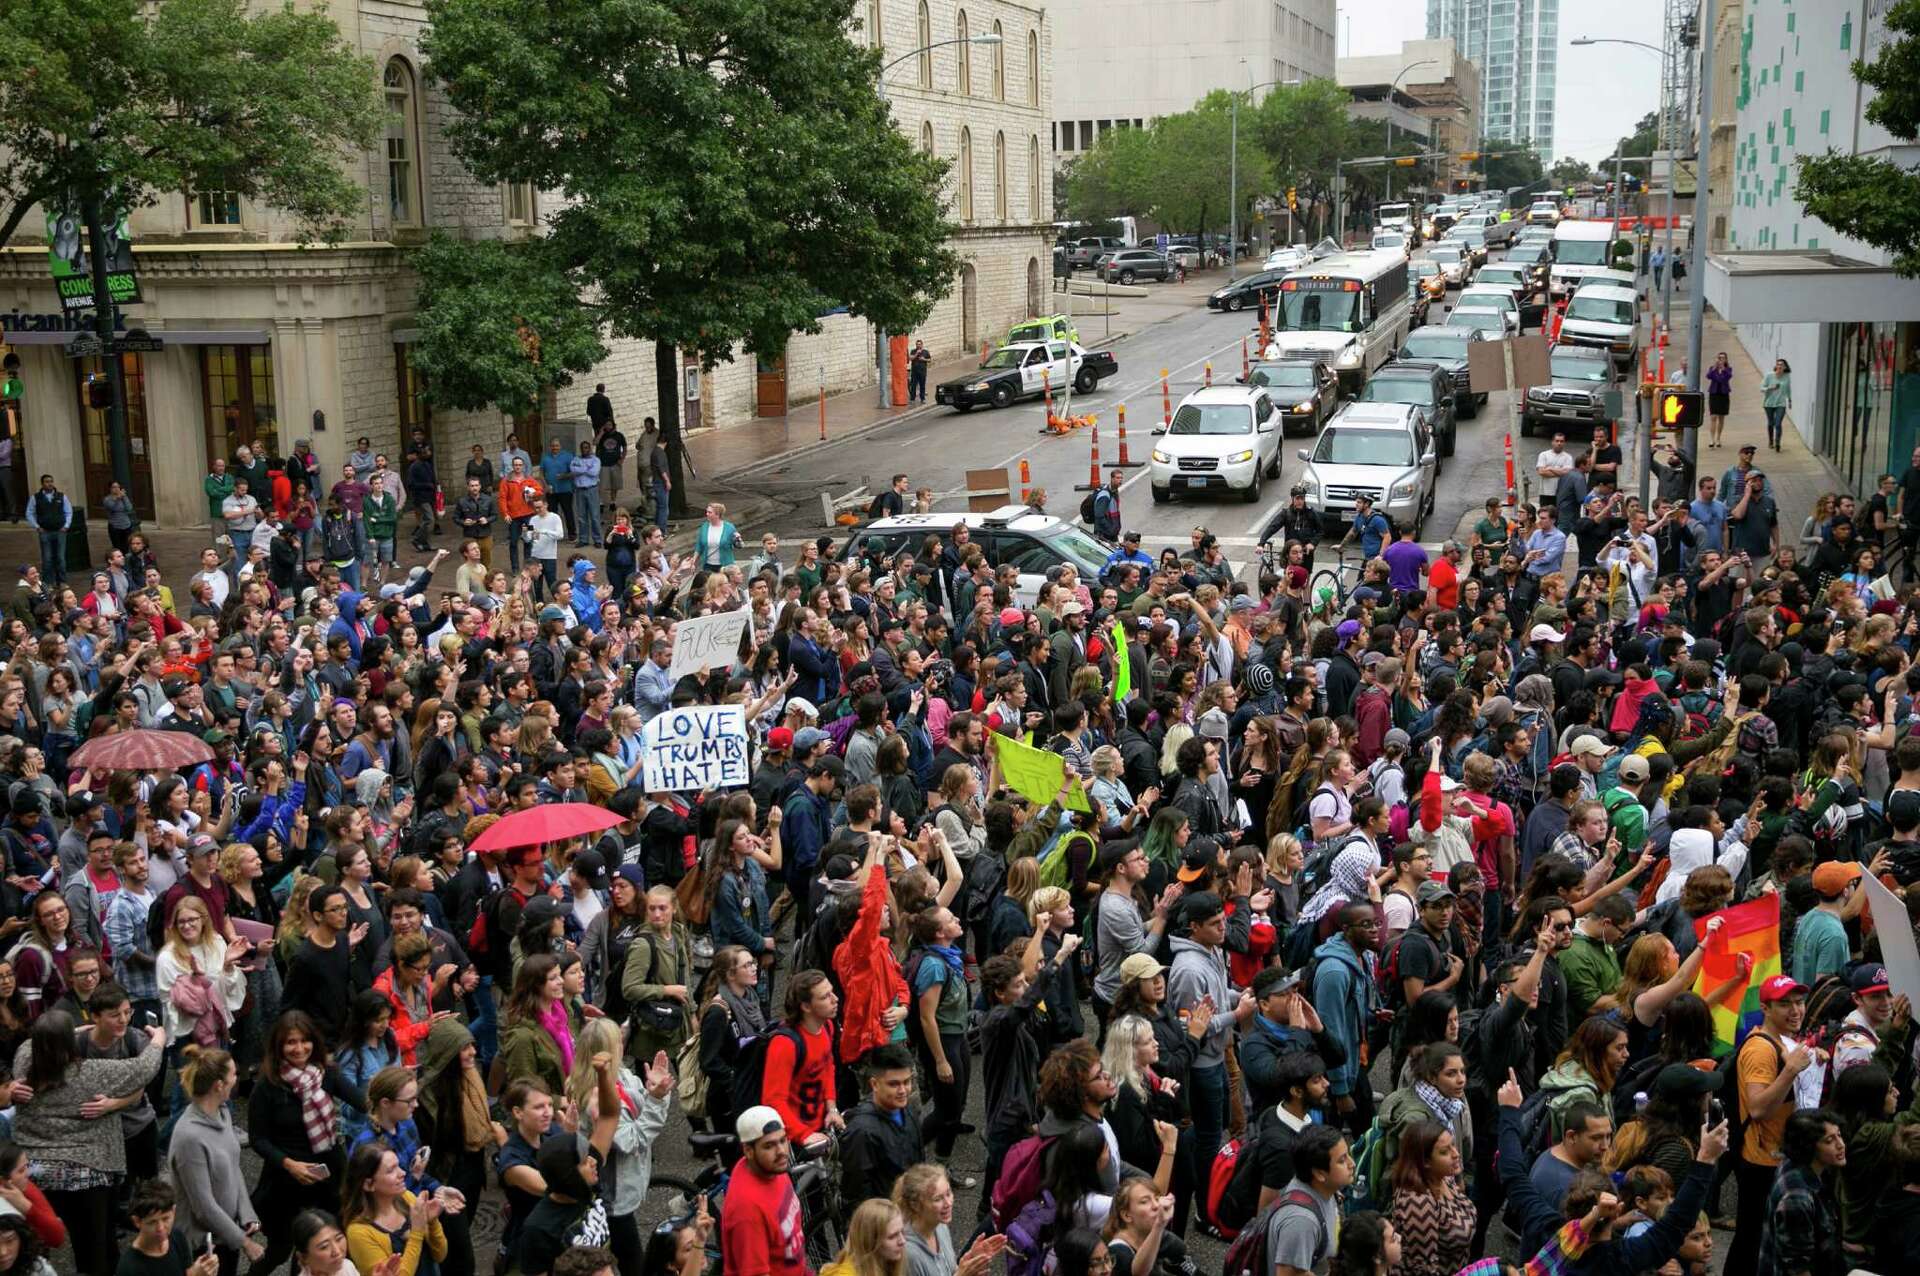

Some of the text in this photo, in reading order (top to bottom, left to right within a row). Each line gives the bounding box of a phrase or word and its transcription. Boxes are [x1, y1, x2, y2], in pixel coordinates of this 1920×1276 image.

[65, 295, 96, 308] AVENUE
[658, 711, 737, 742] LOVE
[652, 734, 745, 768] TRUMPS
